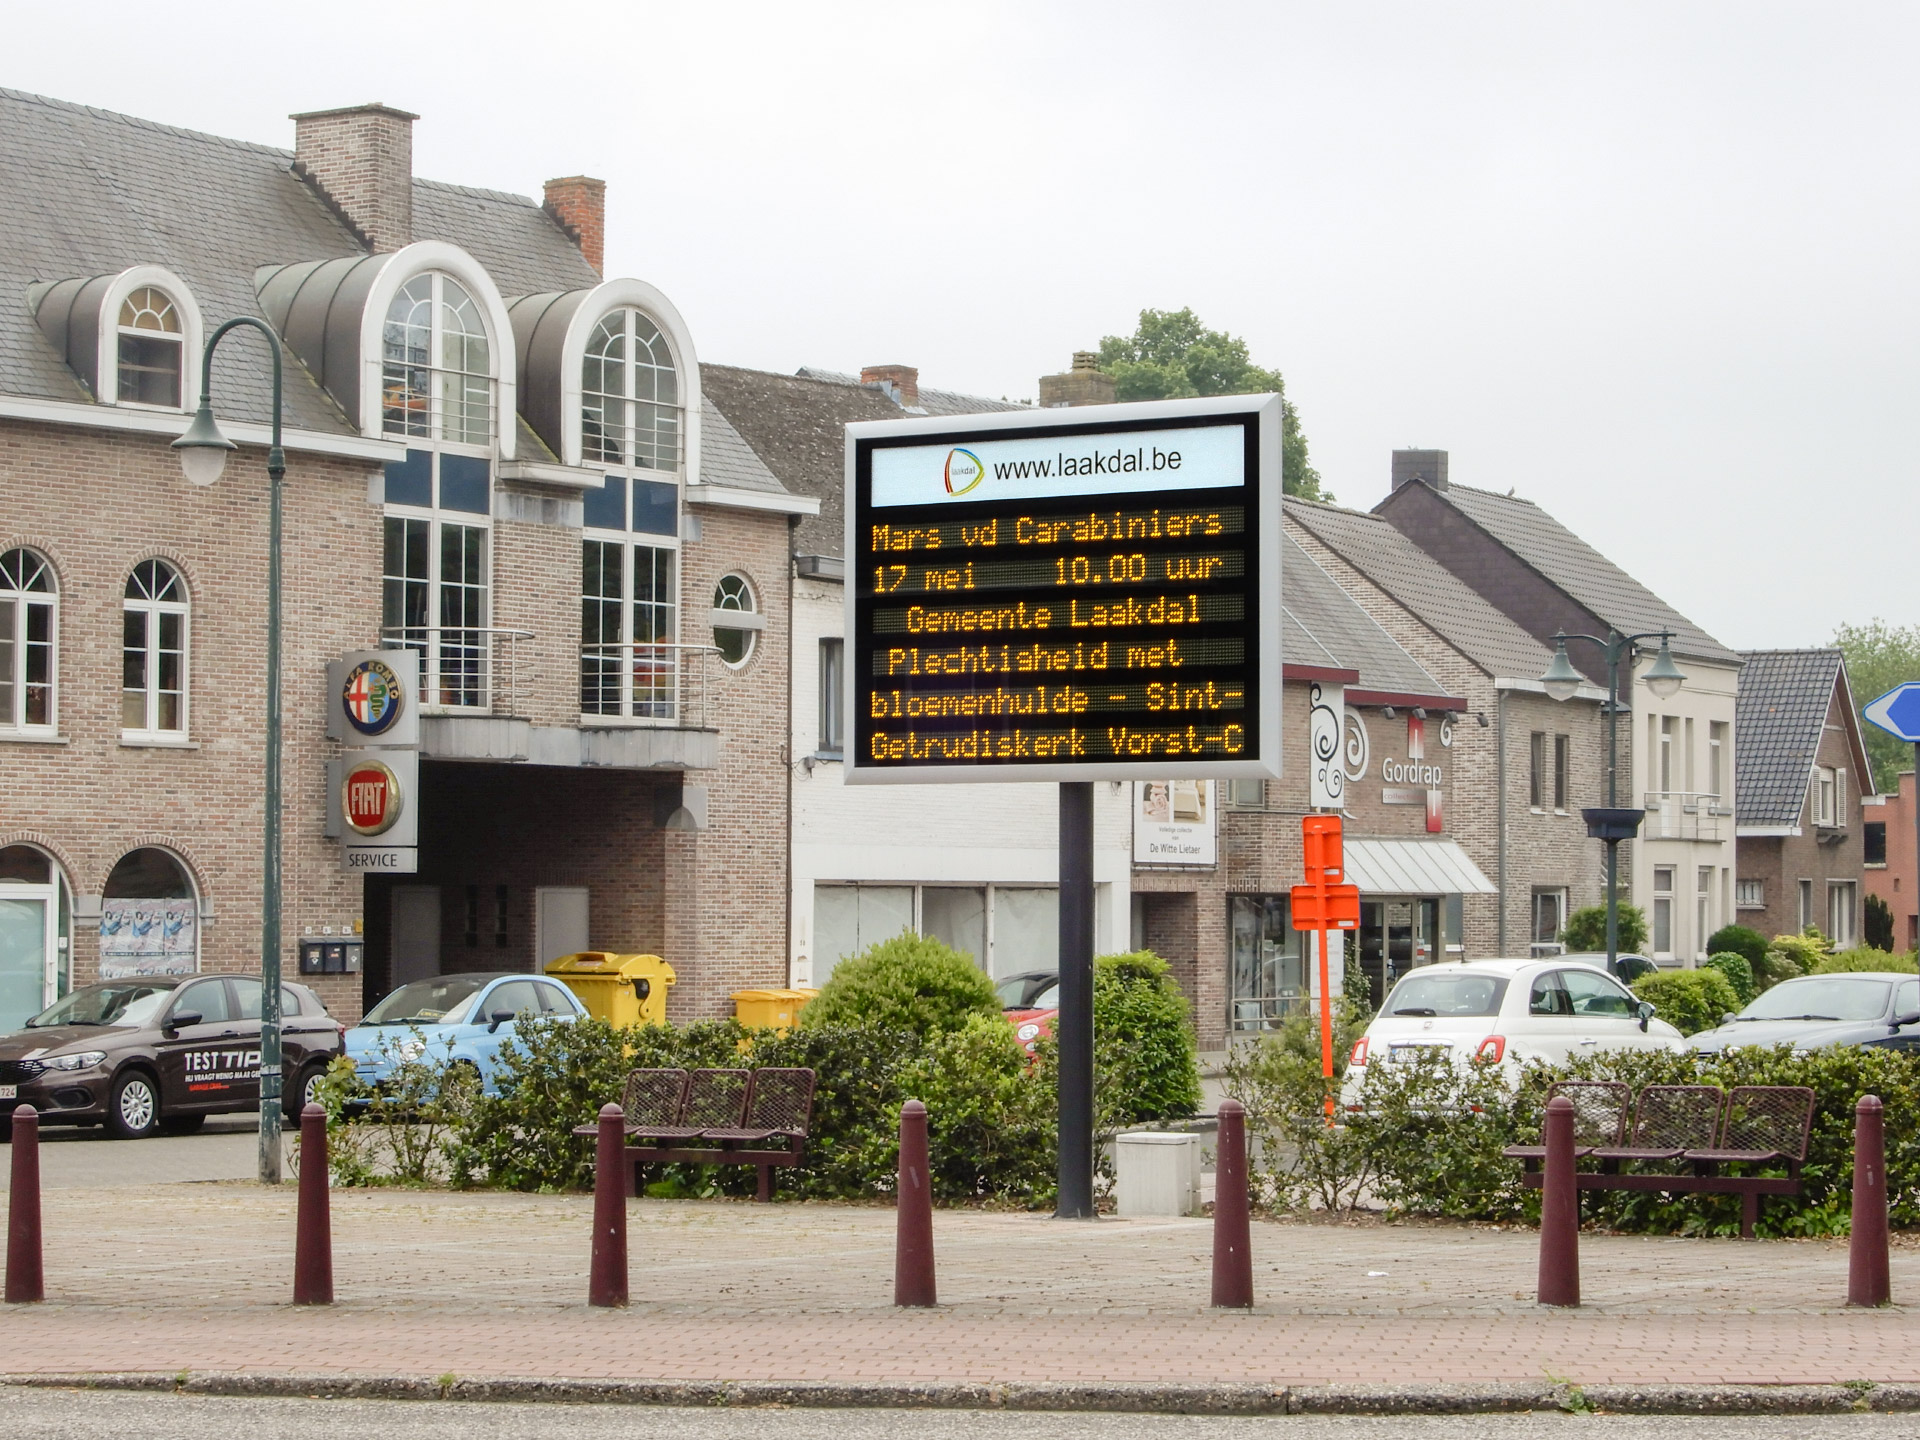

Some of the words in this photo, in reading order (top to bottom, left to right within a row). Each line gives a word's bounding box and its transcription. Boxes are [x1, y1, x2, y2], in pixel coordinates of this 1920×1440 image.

[994, 446, 1182, 480] www.laakdal.be
[871, 524, 943, 552] Mars
[961, 518, 997, 547] vd
[1016, 509, 1223, 544] Carabiniers
[874, 564, 907, 593] 17
[924, 561, 975, 591] mei
[1055, 553, 1146, 585] 10.00
[1166, 557, 1223, 580] uur
[907, 601, 1052, 633] Gemeente
[1070, 594, 1200, 627] Laakdal
[888, 641, 1108, 676] Plechtigheid
[1127, 638, 1184, 668] met
[343, 667, 363, 700] ALFA
[368, 661, 399, 700] ROMEO
[871, 685, 1089, 718] bloemenhulde
[1146, 681, 1243, 711] Sint-
[871, 727, 1085, 760] Getrudiskerk
[1108, 724, 1242, 755] Vorst-C
[1382, 756, 1442, 785] Gordrap
[351, 782, 385, 815] FIAT
[349, 853, 398, 867] SERVICE
[1150, 843, 1159, 853] De
[1160, 843, 1177, 854] Witte
[1179, 844, 1201, 854] Lietaer
[184, 1051, 219, 1071] TEST
[221, 1050, 262, 1069] TIP
